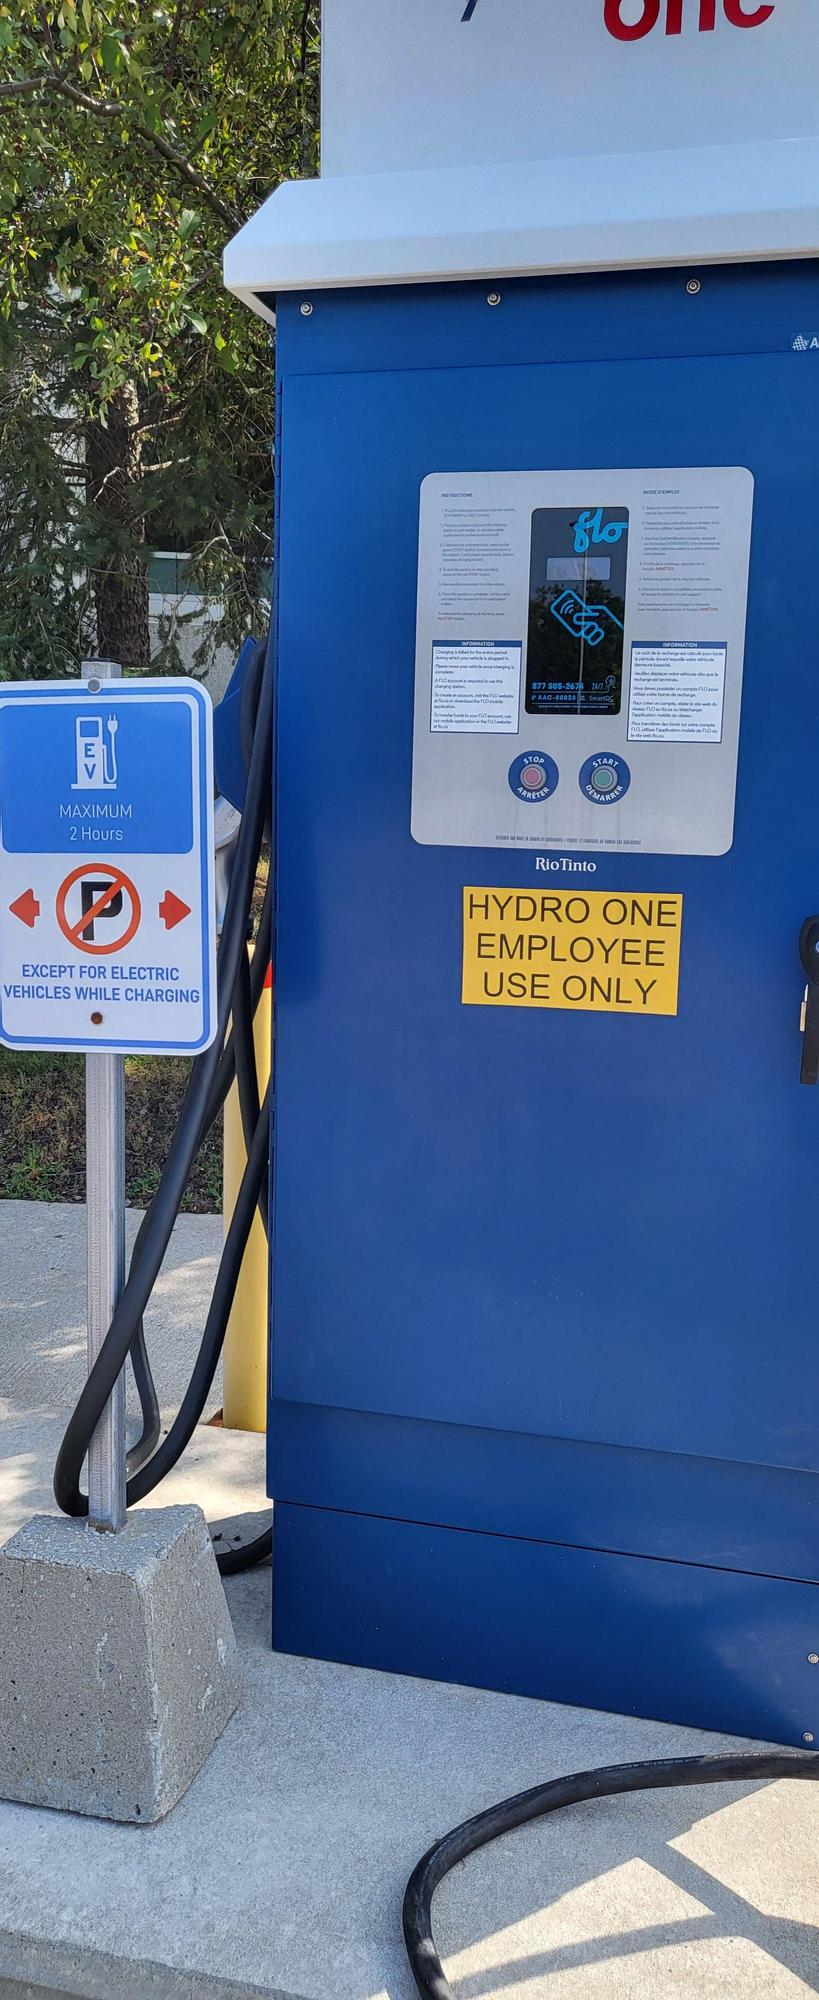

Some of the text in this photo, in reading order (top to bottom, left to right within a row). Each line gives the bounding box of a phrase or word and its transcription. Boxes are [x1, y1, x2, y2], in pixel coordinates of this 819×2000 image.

[574, 508, 629, 553] flo
[523, 756, 545, 764] STOP
[593, 758, 619, 768] START
[59, 804, 132, 819] MAXIMUM
[70, 827, 123, 841] 2 Hours
[469, 894, 677, 927] HYDRO ONE
[477, 933, 666, 967] EMPLOYEE
[22, 964, 180, 981] EXCEPT FOR ELECTRIC
[4, 985, 200, 1003] VEHICLES WHILE CHARGING
[484, 972, 657, 1005] USE ONLY
